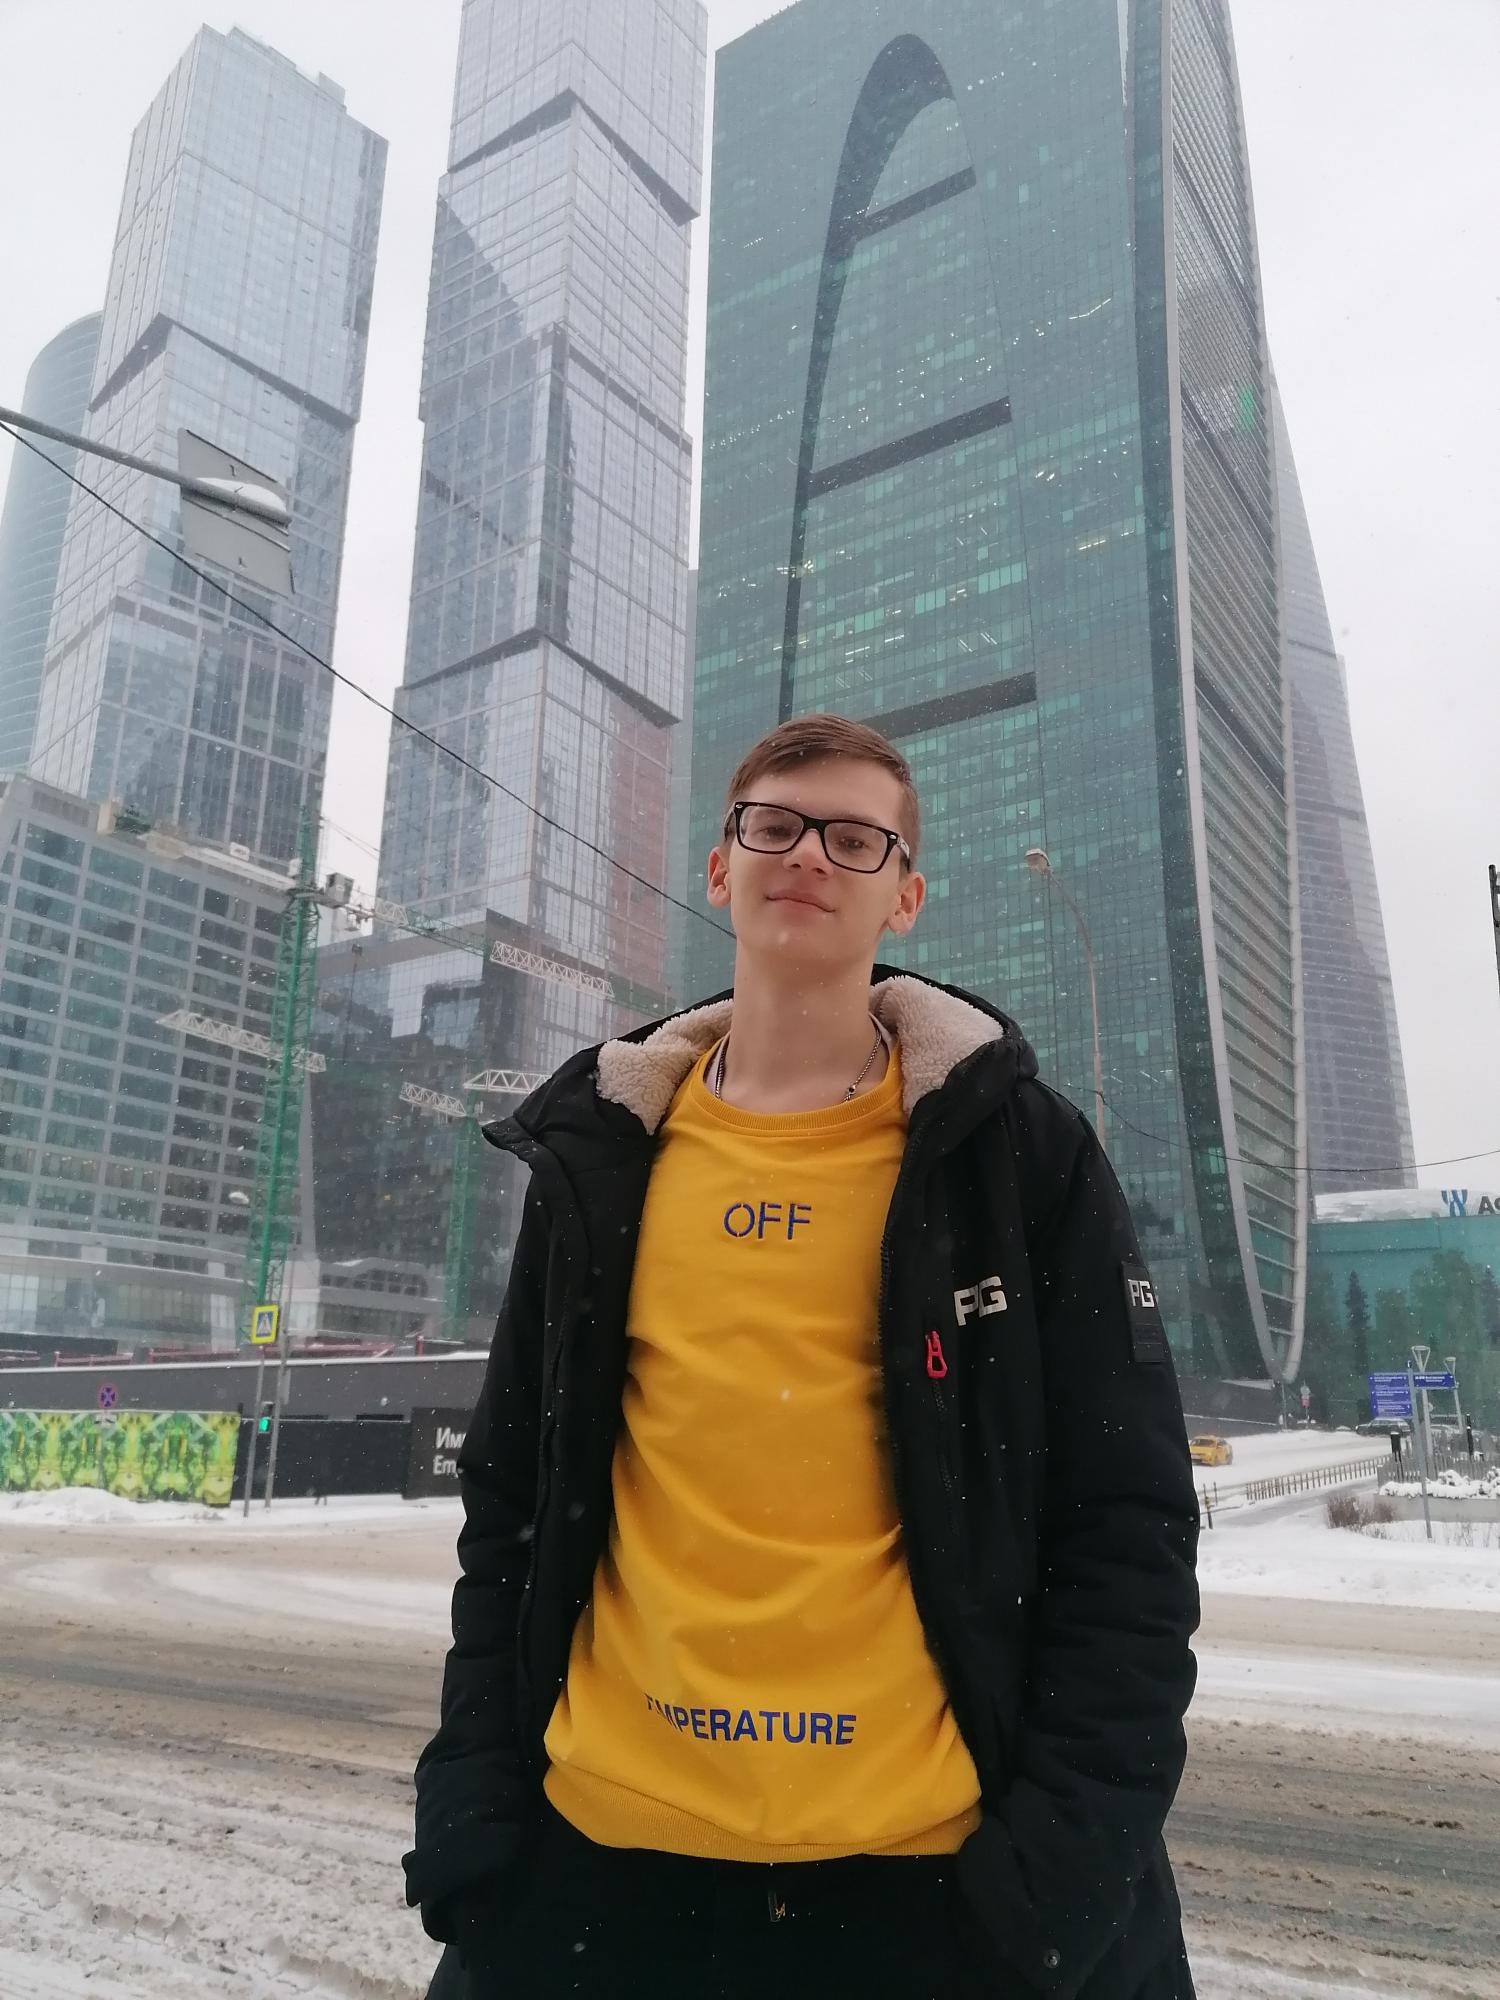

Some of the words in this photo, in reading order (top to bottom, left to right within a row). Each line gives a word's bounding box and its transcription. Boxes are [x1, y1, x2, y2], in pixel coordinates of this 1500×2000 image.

[724, 1202, 812, 1240] OFF
[953, 1276, 1008, 1327] PG
[1127, 1279, 1155, 1308] PG
